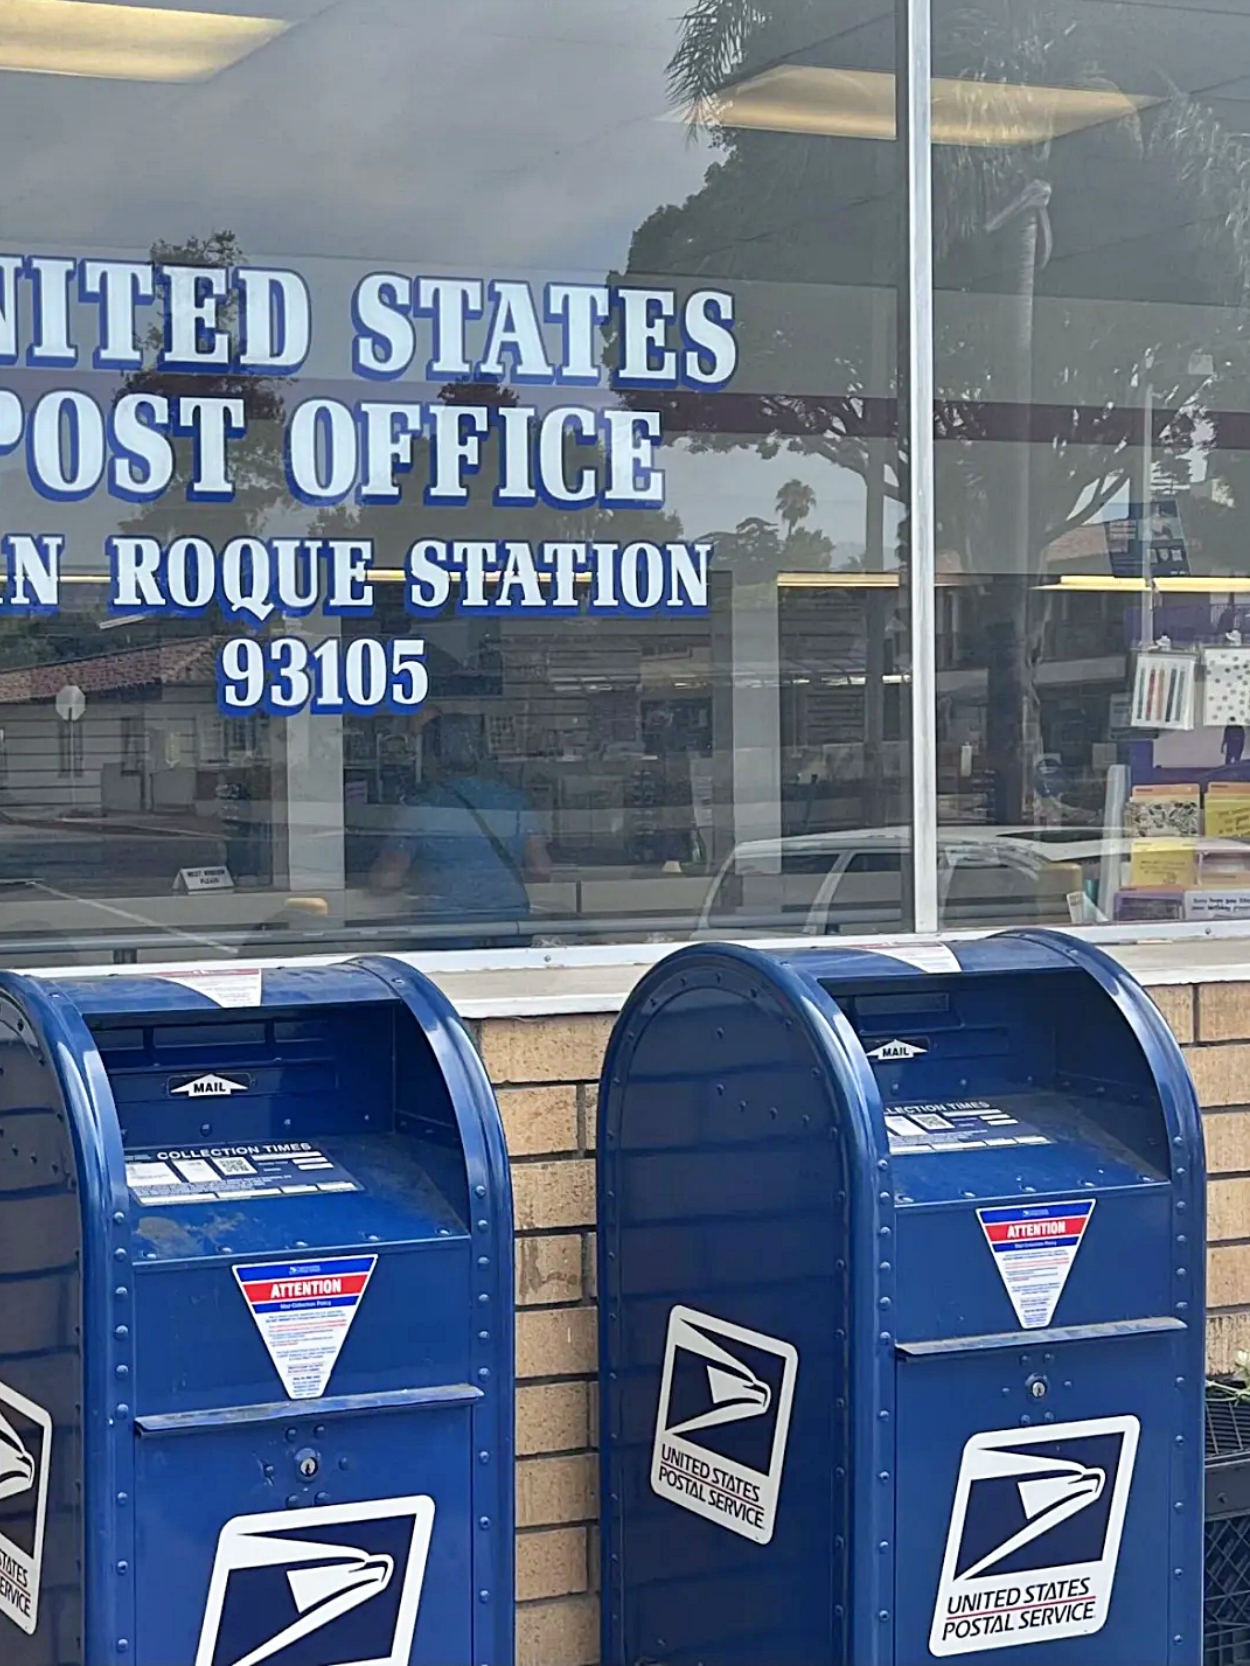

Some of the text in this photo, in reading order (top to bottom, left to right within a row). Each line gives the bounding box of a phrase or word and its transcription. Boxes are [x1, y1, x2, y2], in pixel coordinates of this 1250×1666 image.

[352, 272, 737, 390] STATES
[286, 397, 665, 510] OFFICE
[106, 534, 374, 628] ROQUE
[405, 539, 713, 618] STATION
[217, 637, 430, 715] 93105
[882, 1048, 910, 1057] MAIL
[193, 1082, 227, 1093] MAIL
[946, 1101, 991, 1110] TIMES
[157, 1146, 260, 1160] COLLECTION
[262, 1142, 312, 1153] TIMES
[1007, 1221, 1066, 1238] ATTENTION
[270, 1279, 342, 1298] ATTENTION
[661, 1443, 760, 1501] UNITED STATES
[658, 1466, 765, 1530] POSTAL SERVICE
[947, 1577, 1091, 1614] UNITED STATES
[942, 1601, 1096, 1641] POSTAL SERVICE
